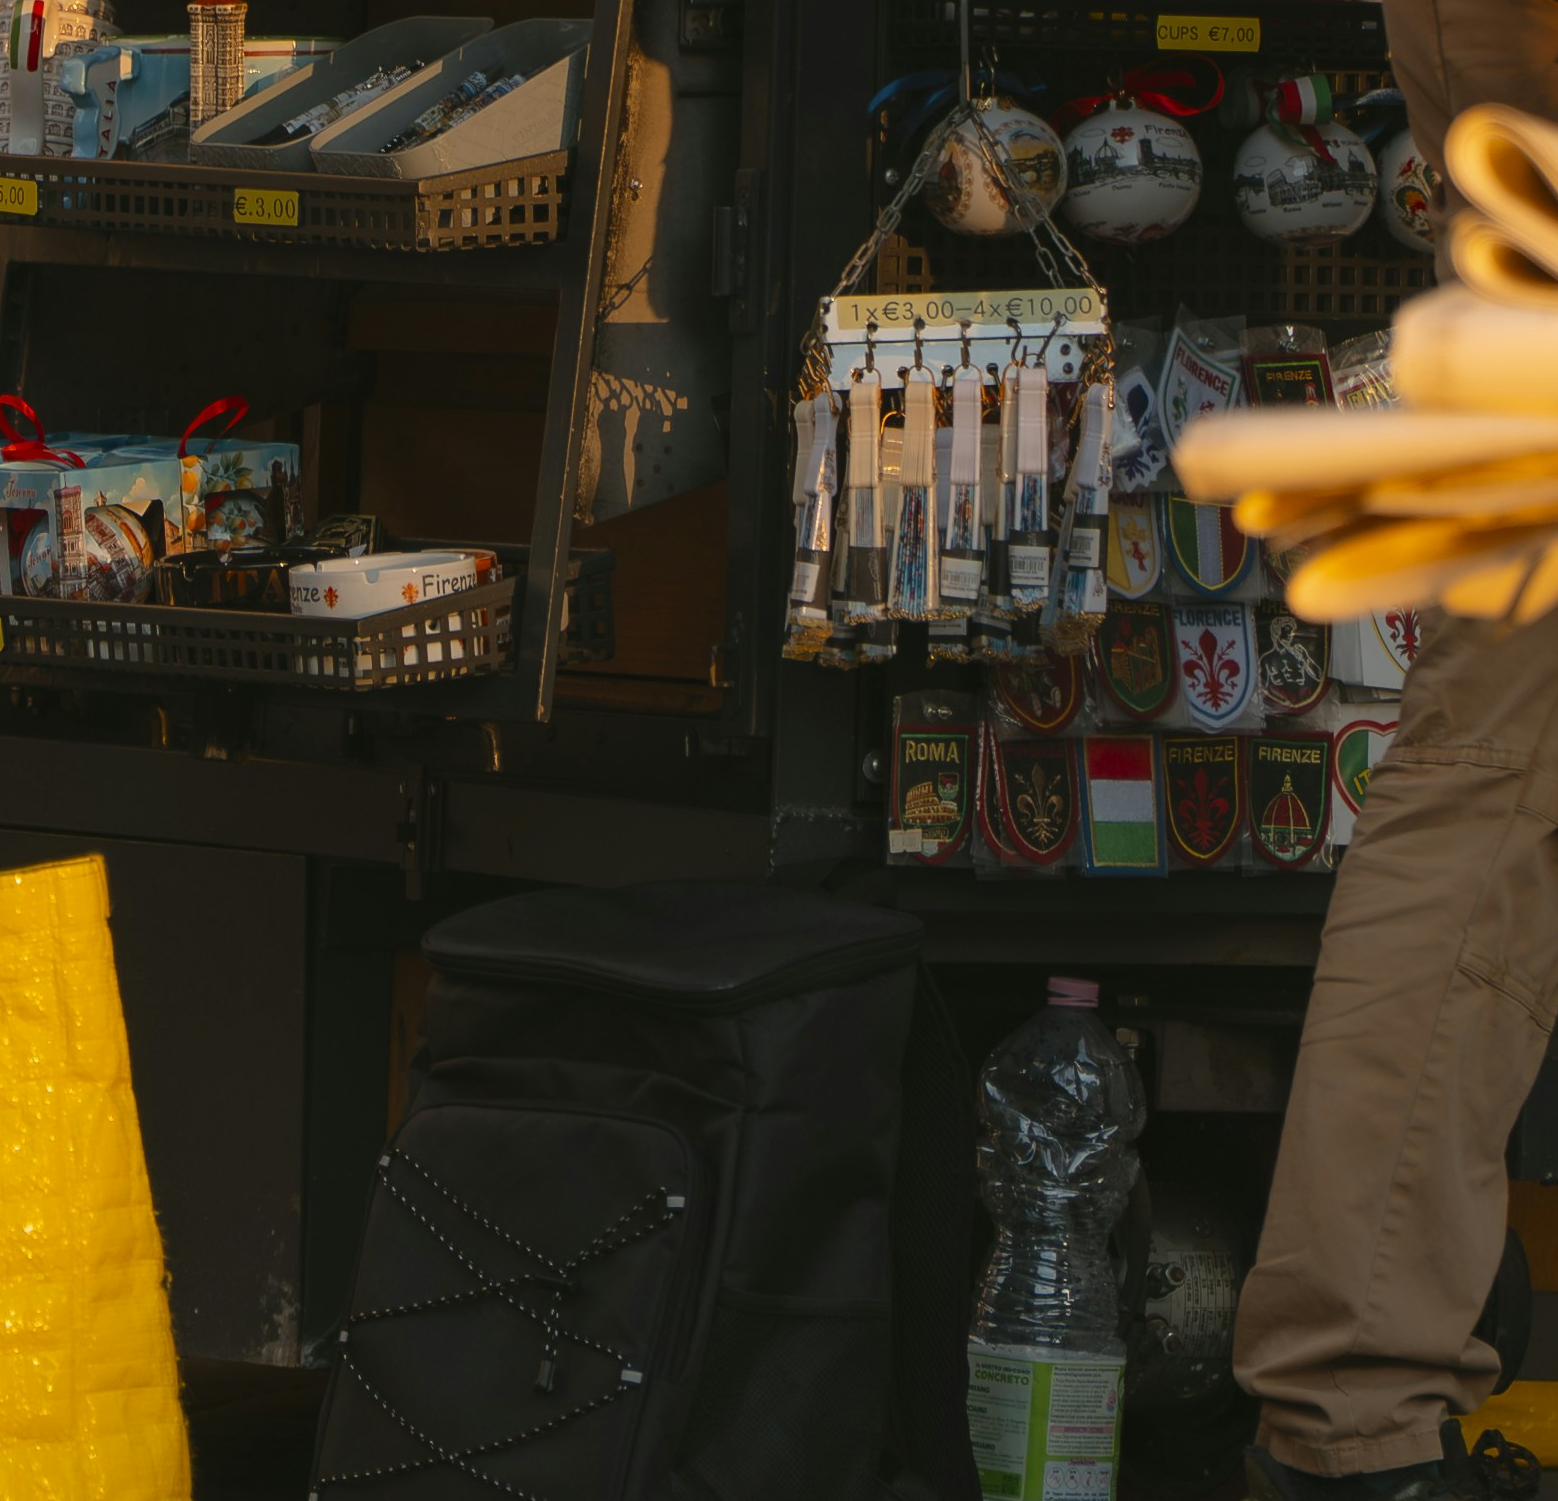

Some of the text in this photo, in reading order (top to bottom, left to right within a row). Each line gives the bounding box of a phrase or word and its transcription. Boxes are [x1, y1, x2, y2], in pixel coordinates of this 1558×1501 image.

[1158, 25, 1198, 40] CUPS
[1175, 346, 1230, 397] FLORENCE
[1265, 369, 1314, 384] FIRENZE
[1174, 606, 1241, 627] FLORENCE
[905, 739, 961, 764] ROMA
[1168, 745, 1235, 765] FIRENZE
[1258, 746, 1322, 765] FIRENZE
[974, 1369, 1030, 1386] CONCRETO
